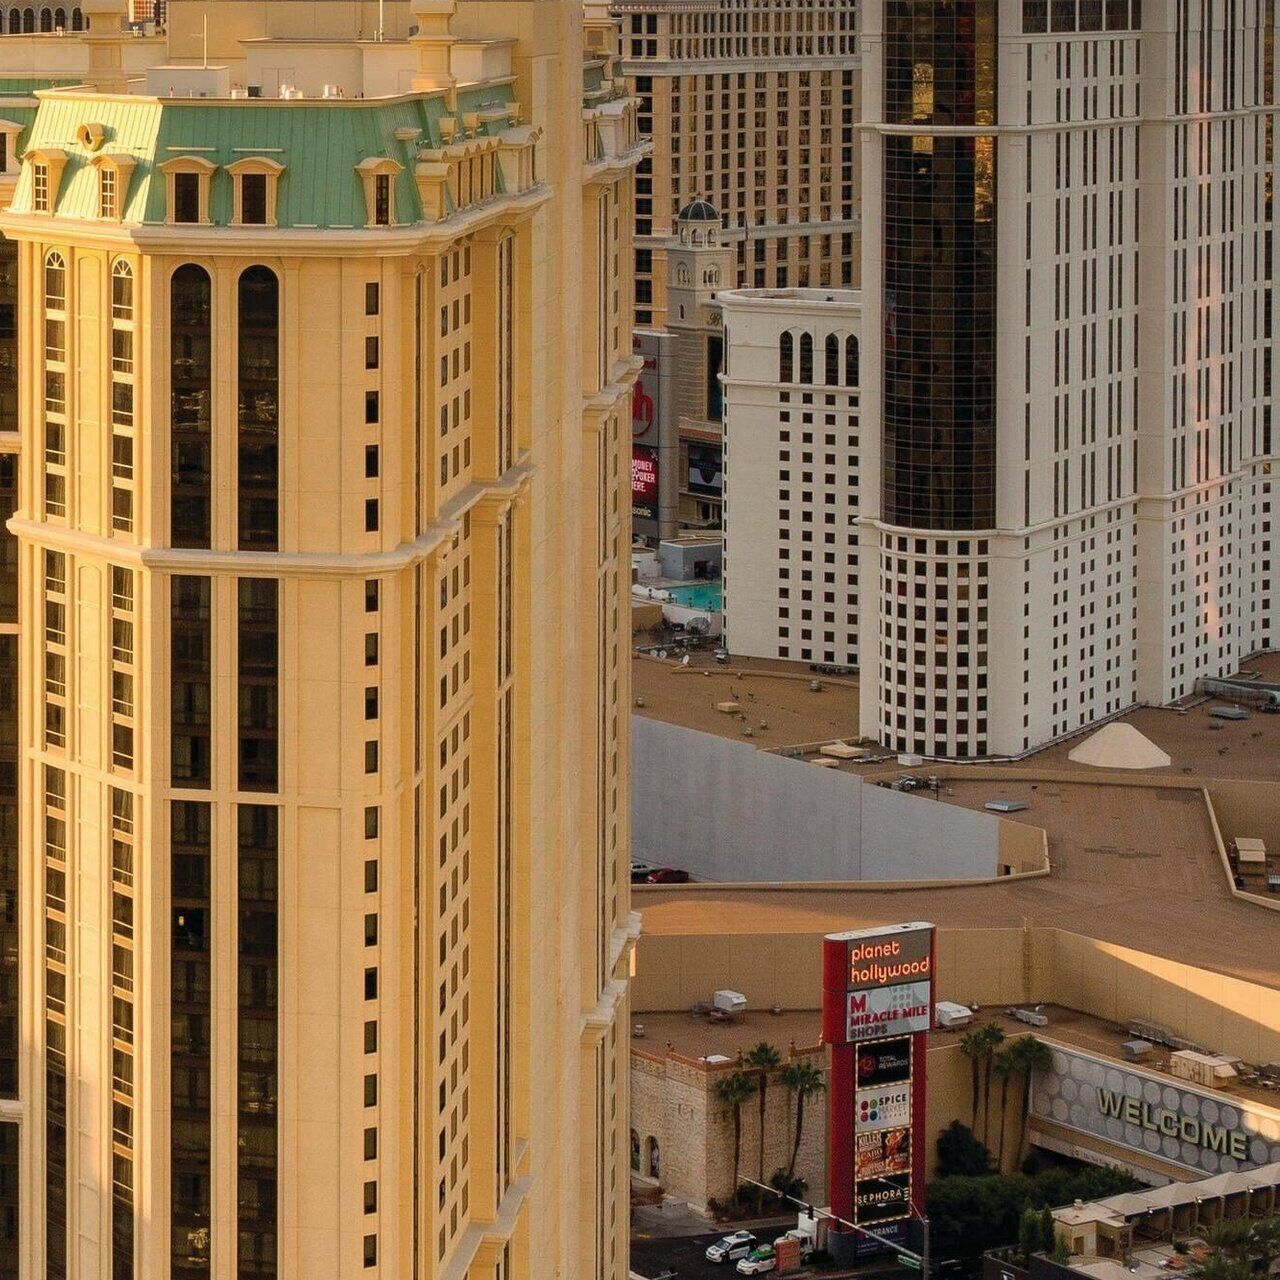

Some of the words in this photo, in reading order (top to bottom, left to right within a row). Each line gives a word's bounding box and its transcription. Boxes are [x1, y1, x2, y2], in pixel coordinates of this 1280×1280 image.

[851, 941, 900, 966] planet
[851, 956, 930, 984] hollywood
[850, 1010, 900, 1027] MIRACLE
[902, 1005, 929, 1019] MILE
[850, 1024, 888, 1039] SHOPS
[879, 1093, 908, 1106] SPICE
[1097, 1087, 1249, 1161] WELCOME
[858, 1189, 902, 1204] SEPHORA
